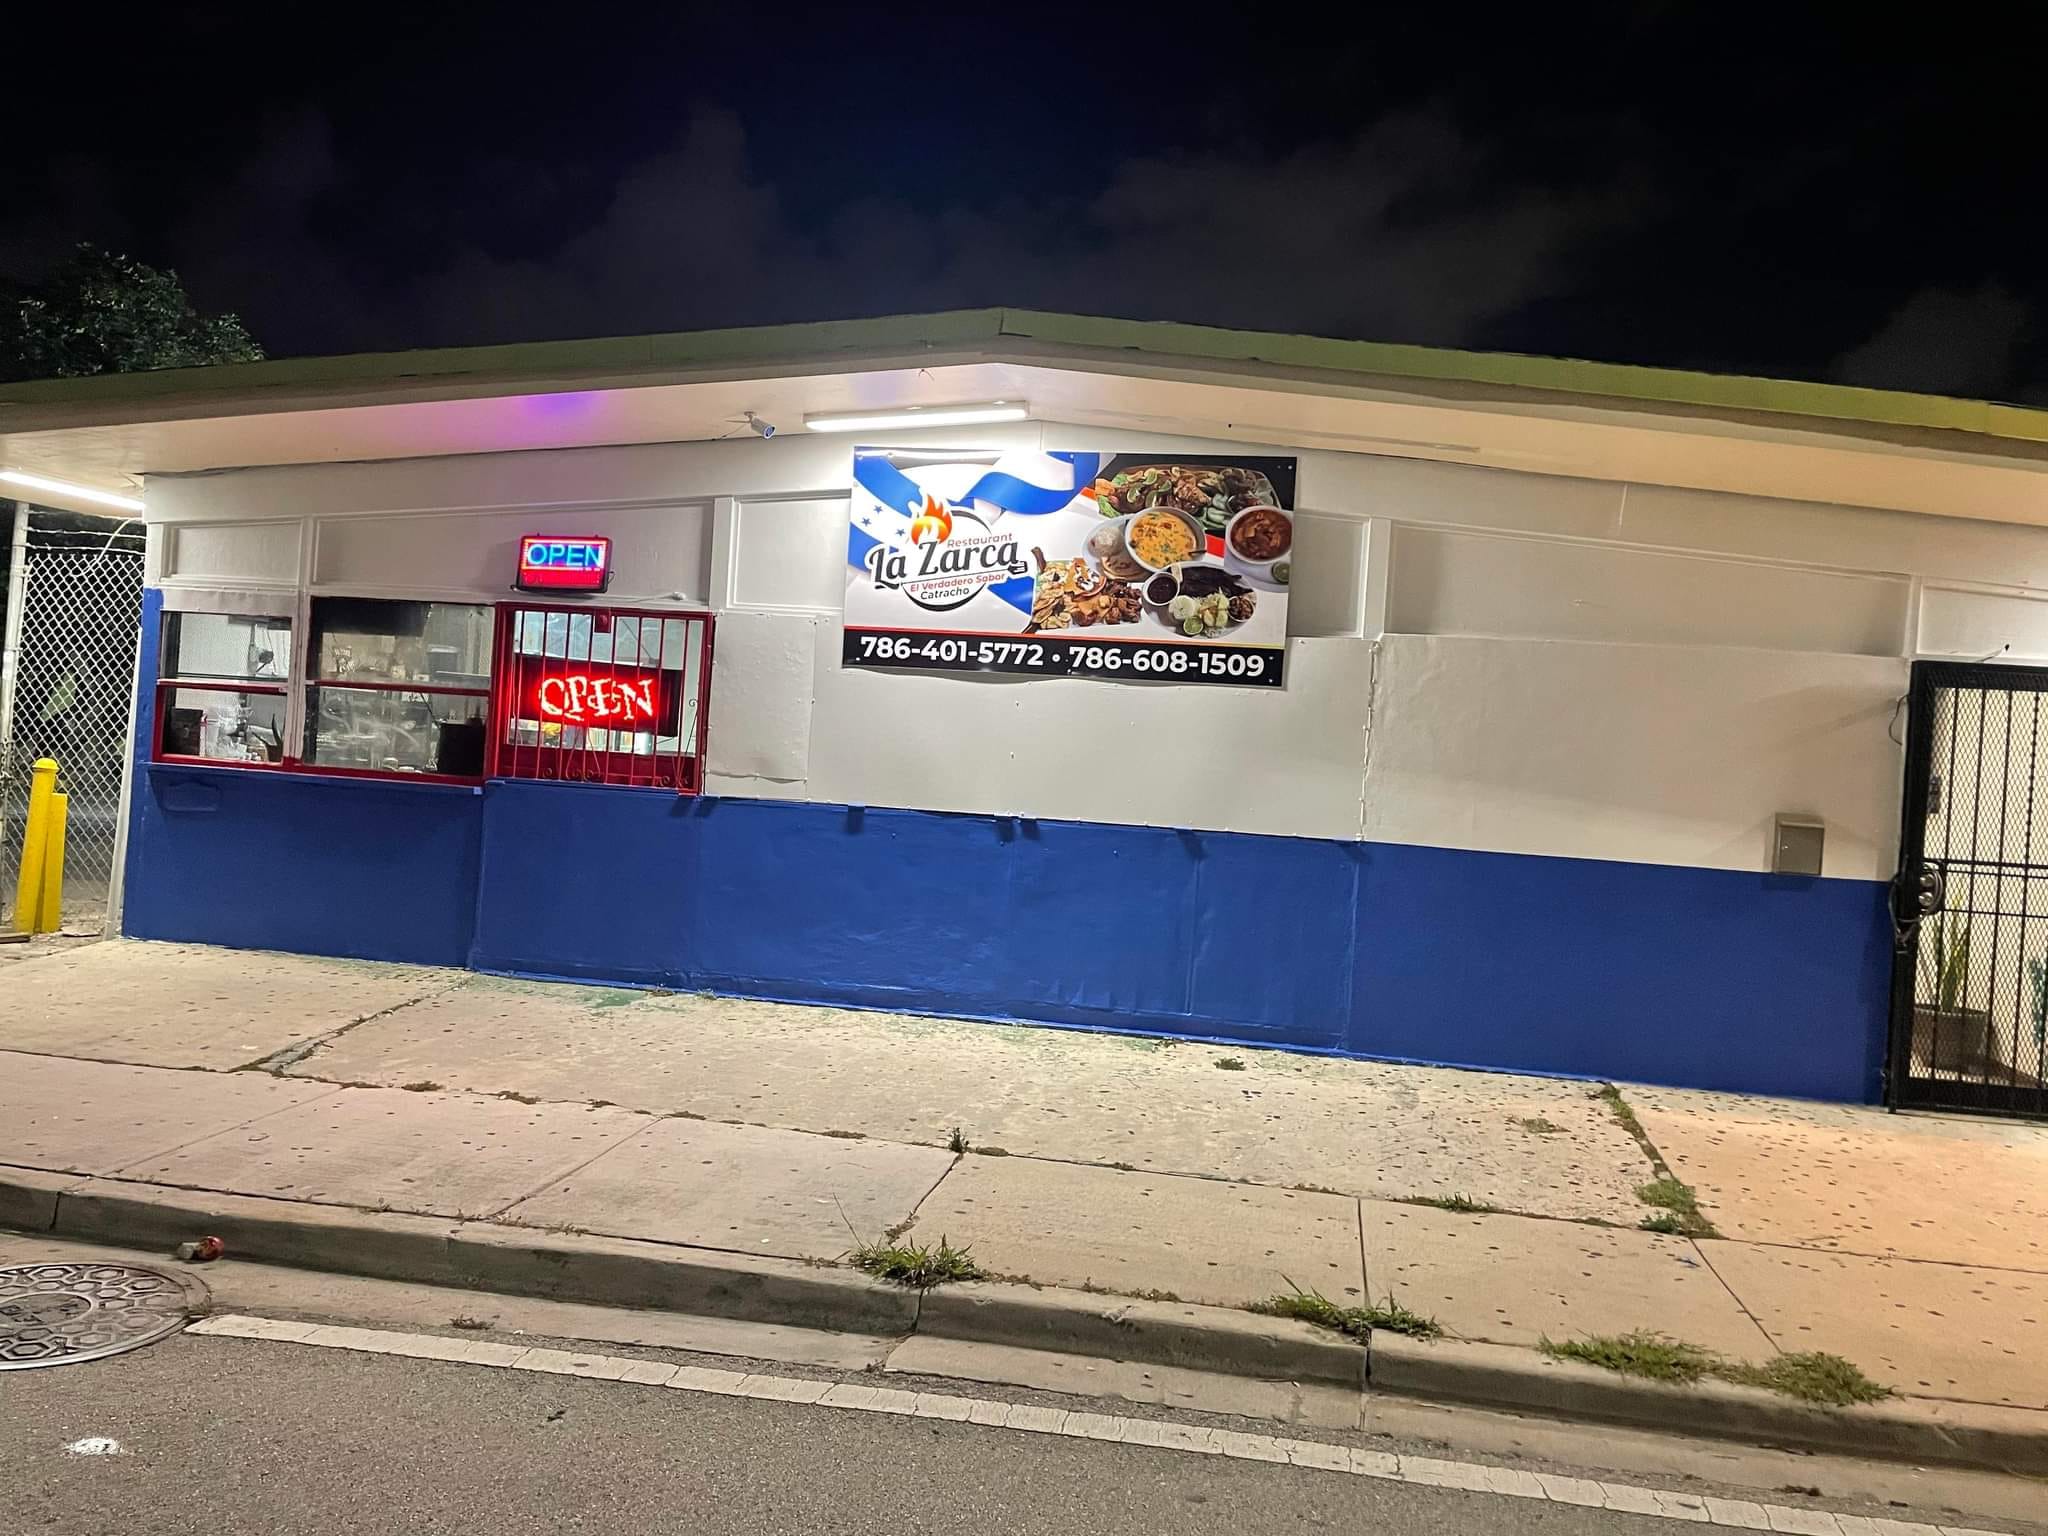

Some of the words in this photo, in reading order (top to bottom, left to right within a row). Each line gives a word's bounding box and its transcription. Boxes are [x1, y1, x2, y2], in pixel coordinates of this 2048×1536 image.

[947, 533, 1012, 548] Restaurant
[528, 544, 603, 566] OPEN
[869, 548, 907, 590] La
[918, 540, 1020, 577] Zarca
[910, 584, 919, 592] El
[922, 578, 973, 591] Verdadero
[976, 573, 1005, 584] Sabor
[920, 586, 970, 600] Catracho
[860, 636, 1044, 666] 786-401-5772
[1069, 646, 1265, 677] 786-608-1509
[540, 676, 653, 721] OPEN
